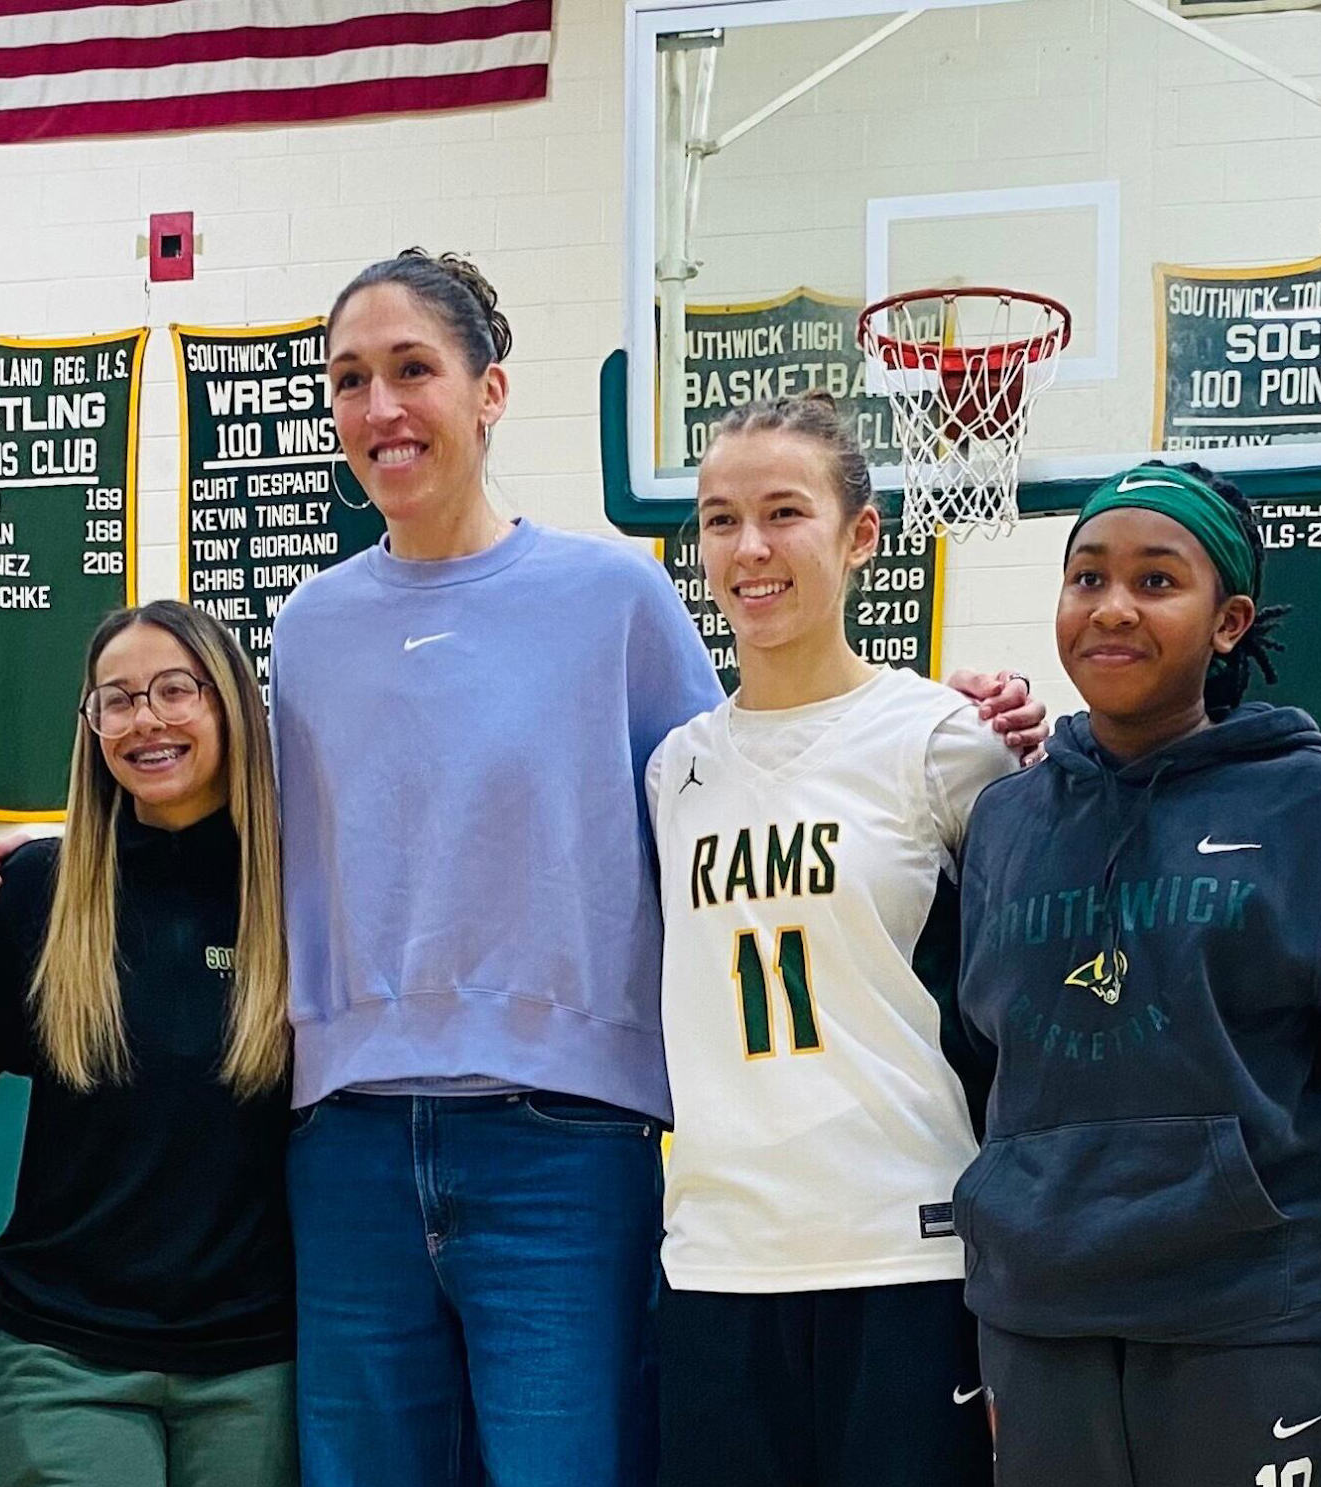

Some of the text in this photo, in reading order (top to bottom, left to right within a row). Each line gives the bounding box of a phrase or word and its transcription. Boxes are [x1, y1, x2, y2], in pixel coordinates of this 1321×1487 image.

[792, 320, 843, 352] HIGH
[53, 355, 91, 387] REG.
[96, 349, 129, 382] H.S.
[1189, 369, 1243, 410] 100
[217, 417, 336, 459] 100 WINS
[31, 438, 98, 475] CLUB
[84, 488, 123, 511] 169
[192, 470, 330, 502] CURT DESPARD
[84, 519, 123, 543] 168
[191, 502, 332, 532] KEVIN TINGLEY
[192, 532, 338, 562] TONY GIORDANO
[83, 551, 123, 575] 206
[192, 567, 245, 592] CHRIS
[861, 566, 926, 592] 1208
[857, 599, 920, 626] 2710
[858, 636, 919, 662] 1009
[691, 820, 840, 910] RAMS
[730, 923, 826, 1063] 11
